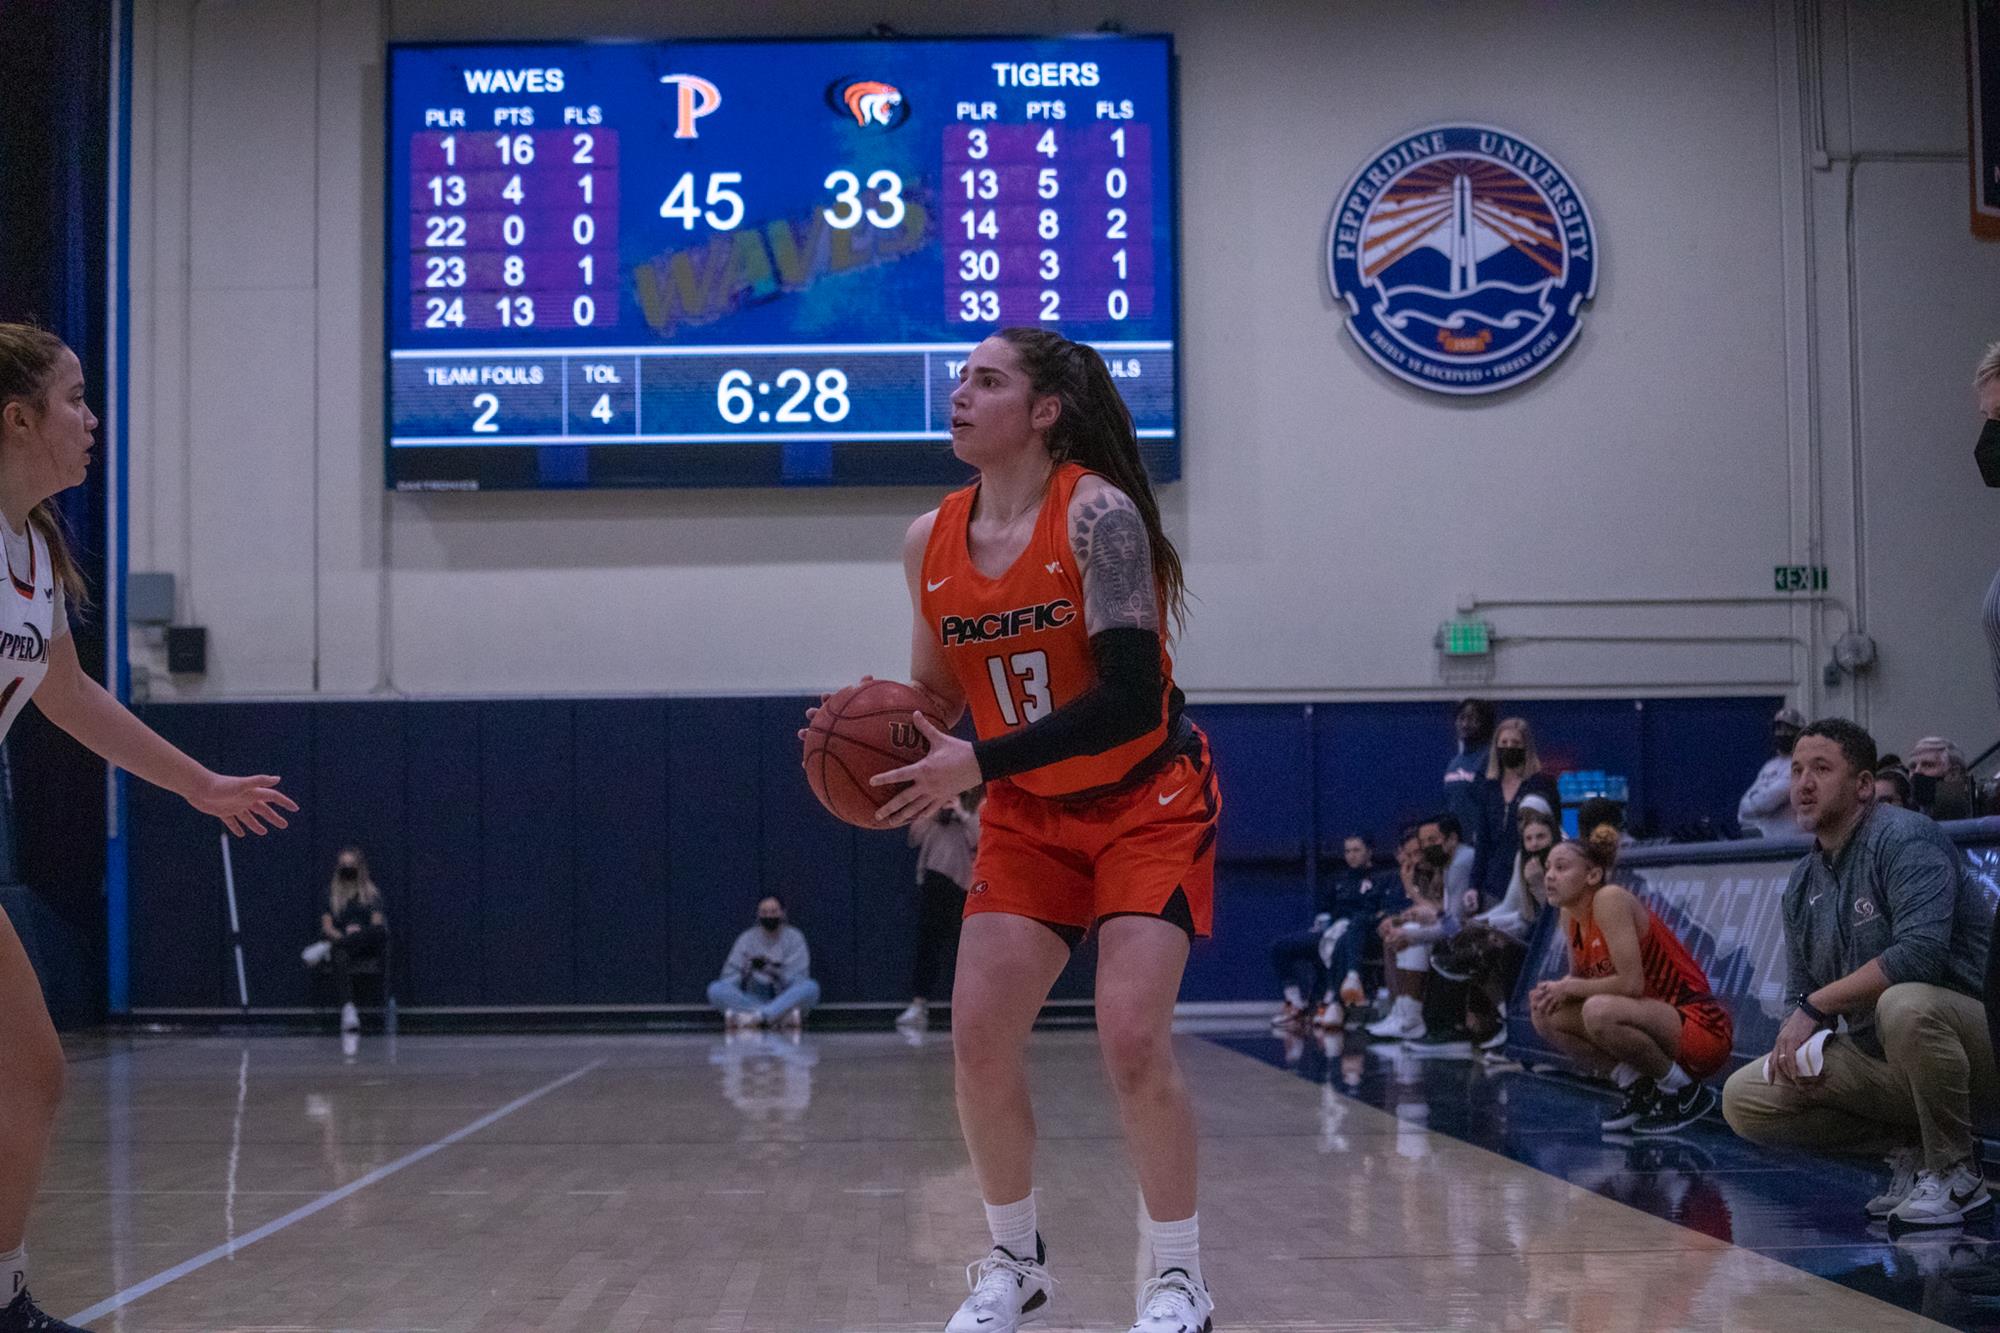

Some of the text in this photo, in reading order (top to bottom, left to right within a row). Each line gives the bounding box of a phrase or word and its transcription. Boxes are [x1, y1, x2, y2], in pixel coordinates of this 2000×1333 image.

[464, 69, 564, 94] WAVES
[992, 62, 1100, 87] TIGERS
[425, 105, 602, 127] PLR PTS FLS
[661, 74, 721, 139] P
[956, 100, 1134, 120] PLR PTS FLS
[441, 134, 594, 165] 1 16 2
[968, 128, 1124, 159] 3 4 1
[429, 175, 592, 206] 13 4 1
[961, 168, 1127, 199] 13 5 0
[1337, 132, 1589, 261] PEPPERDINE UNIVERSITY
[660, 173, 744, 230] 45
[823, 170, 905, 229] 33
[425, 214, 594, 247] 22 0 0
[961, 209, 1127, 240] 14 8 2
[425, 255, 593, 288] 23 8 1
[960, 249, 1126, 281] 30 3 1
[425, 296, 594, 328] 24 13 0
[960, 290, 1129, 321] 33 2 0
[424, 365, 544, 386] TEAM FOULS
[582, 364, 621, 384] TOL
[591, 394, 613, 423] 4
[717, 368, 850, 424] 6:28
[472, 393, 499, 432] 2
[941, 599, 1077, 647] PACIFIC
[985, 649, 1054, 726] 13
[12, 1270, 24, 1293] P
